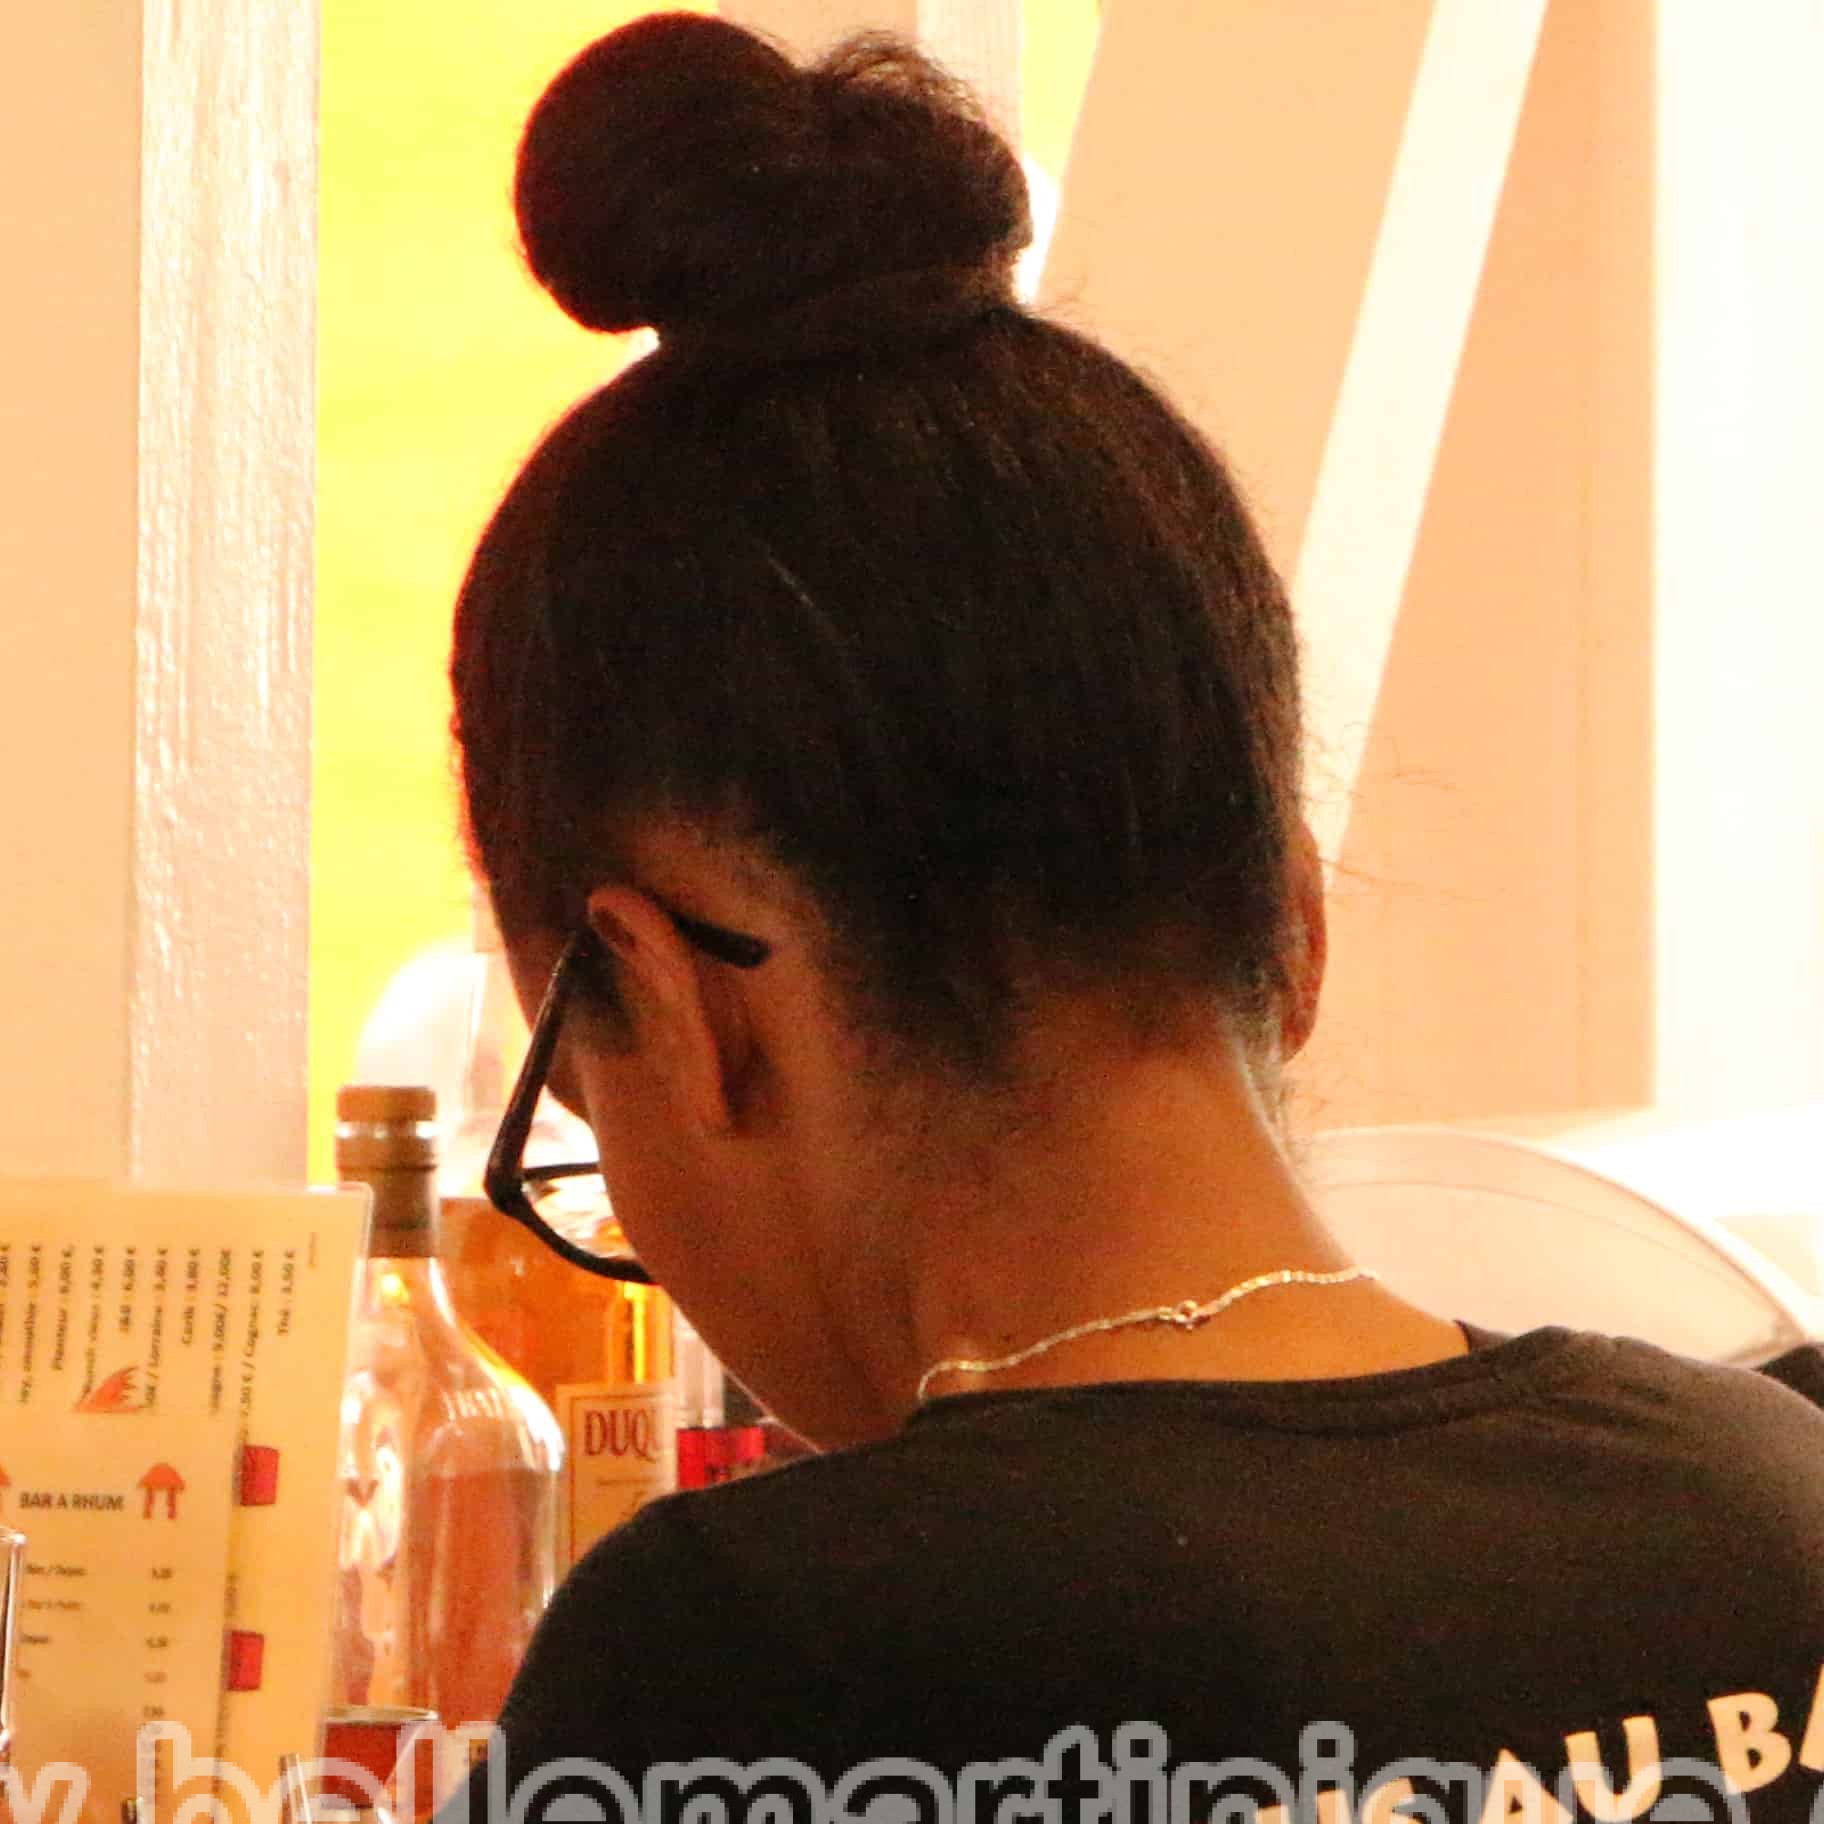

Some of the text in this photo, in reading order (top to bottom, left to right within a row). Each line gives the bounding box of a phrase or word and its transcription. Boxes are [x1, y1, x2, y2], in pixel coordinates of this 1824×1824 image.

[584, 1408, 660, 1464] DUQ
[19, 1491, 53, 1510] BAR
[72, 1493, 125, 1512] RHUM
